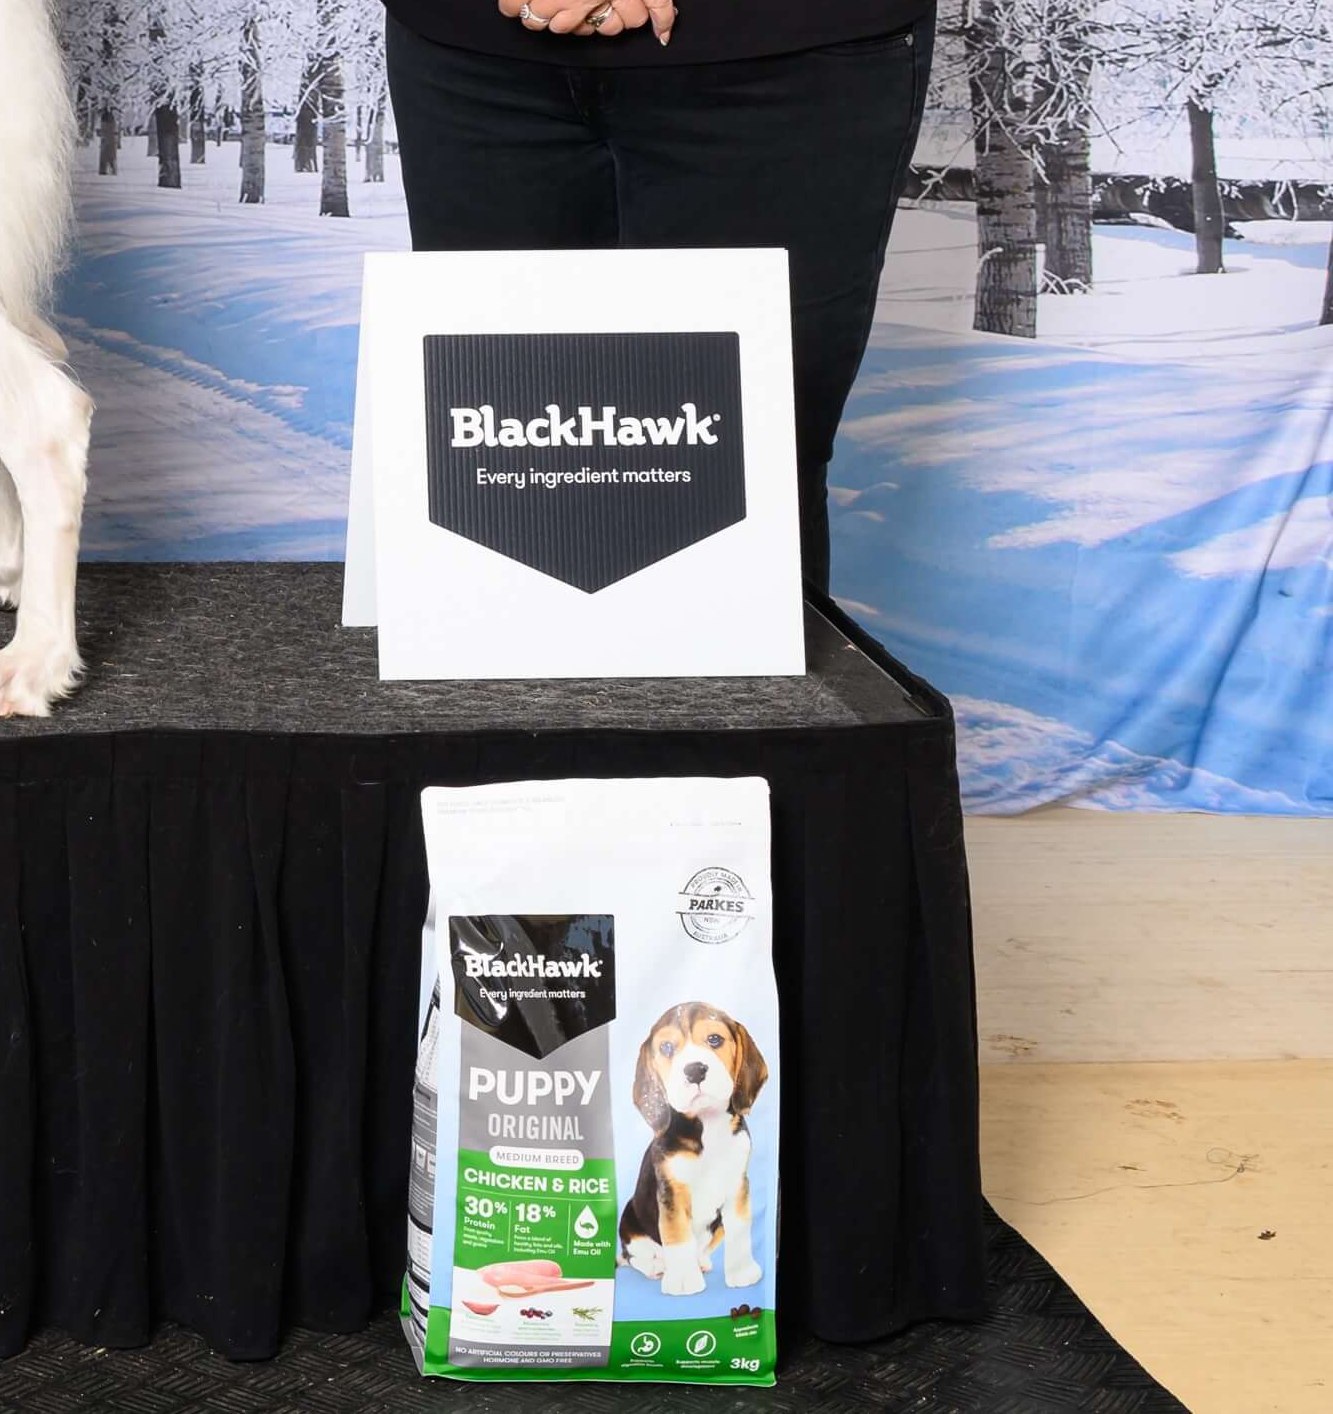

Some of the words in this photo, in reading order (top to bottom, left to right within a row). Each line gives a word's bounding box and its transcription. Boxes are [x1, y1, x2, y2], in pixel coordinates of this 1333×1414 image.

[450, 403, 720, 448] BlackHawk
[477, 468, 526, 489] Every
[530, 467, 619, 488] ingredient
[623, 469, 691, 483] matters
[689, 899, 745, 913] PARKES
[464, 953, 602, 979] BlackHawk
[479, 987, 508, 1000] Every
[508, 987, 548, 1001] ingredient
[549, 989, 585, 999] matters
[468, 1066, 601, 1106] PUPPY
[487, 1113, 584, 1141] ORIGINAL
[496, 1151, 542, 1163] MEDIUM
[545, 1154, 579, 1164] BREED
[464, 1167, 547, 1191] CHICKEN
[552, 1178, 564, 1192] &
[569, 1178, 609, 1194] RICE
[464, 1195, 508, 1218] 30%
[515, 1202, 556, 1223] 18%
[464, 1216, 495, 1230] Protein
[514, 1224, 530, 1234] Fat
[595, 1240, 611, 1248] with
[455, 1346, 466, 1354] NO
[730, 1358, 760, 1371] 3kg
